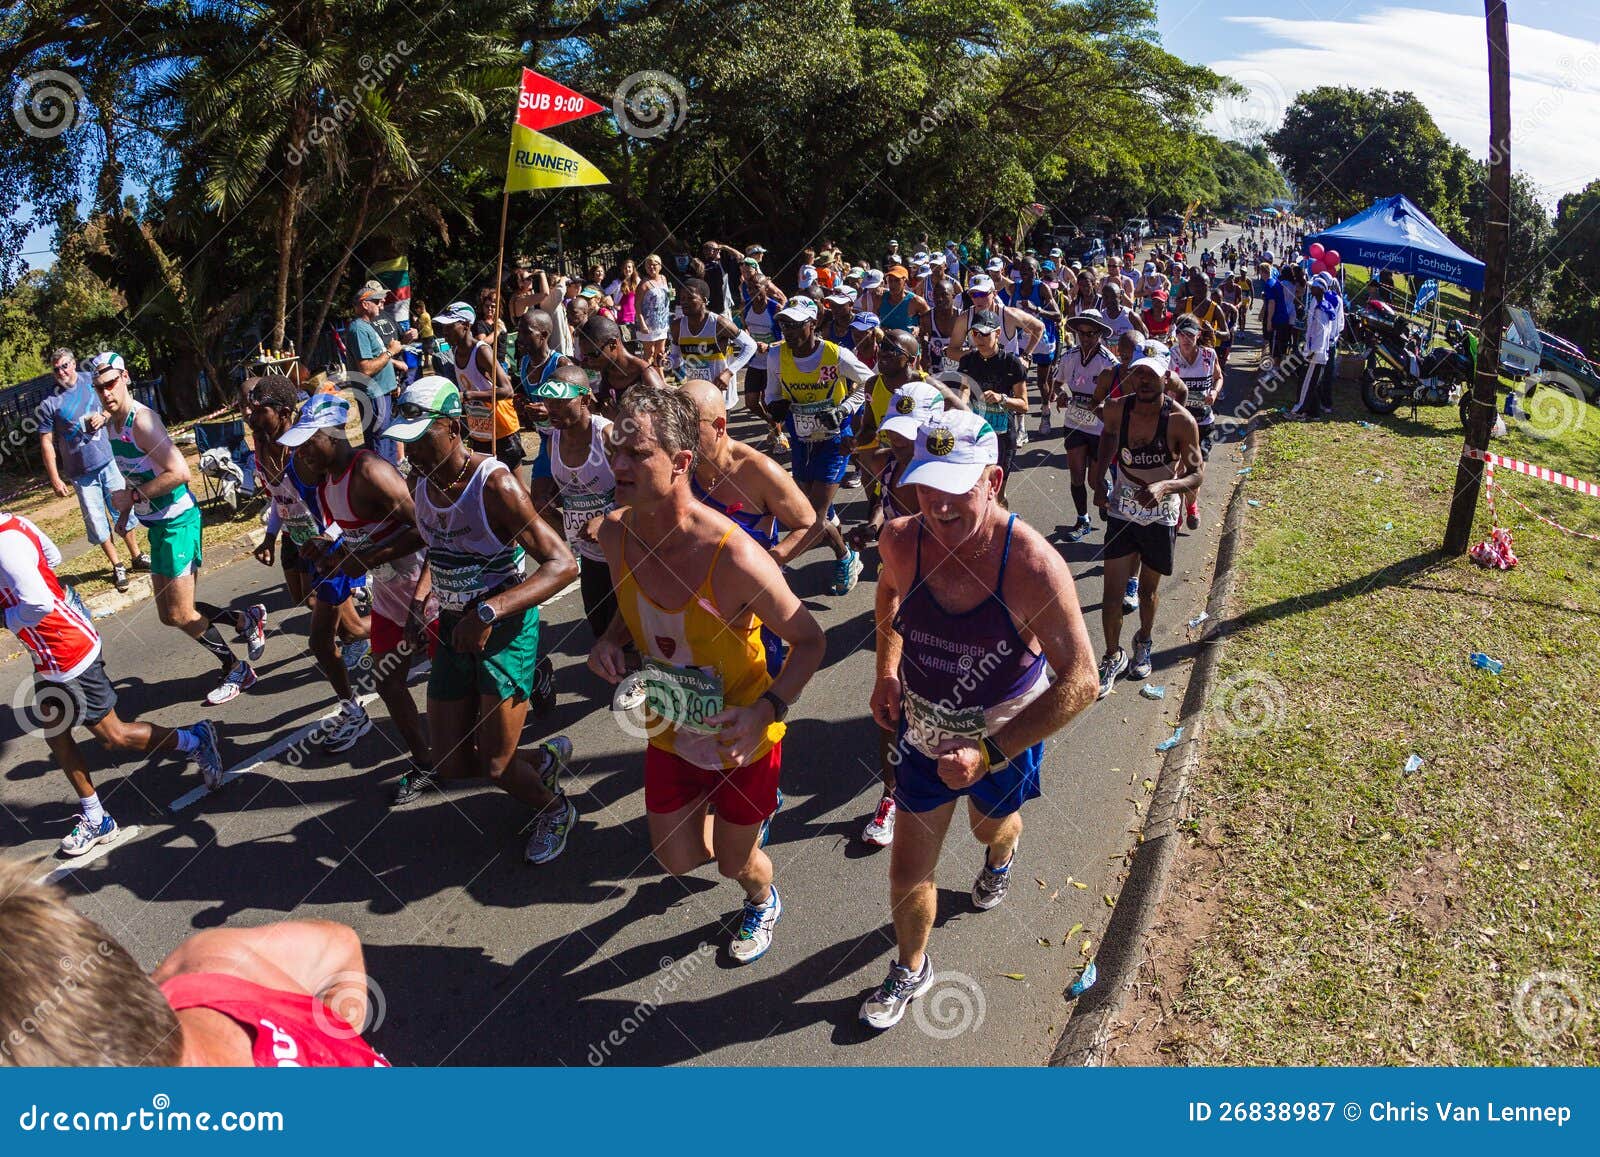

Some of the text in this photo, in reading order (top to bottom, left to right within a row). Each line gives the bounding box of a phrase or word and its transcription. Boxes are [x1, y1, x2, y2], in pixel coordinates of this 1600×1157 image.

[519, 92, 584, 112] SUB 9:00
[1359, 247, 1405, 264] Lew Geffen
[1417, 254, 1462, 276] Sotheby's
[910, 629, 986, 658] QUEENSBURGH
